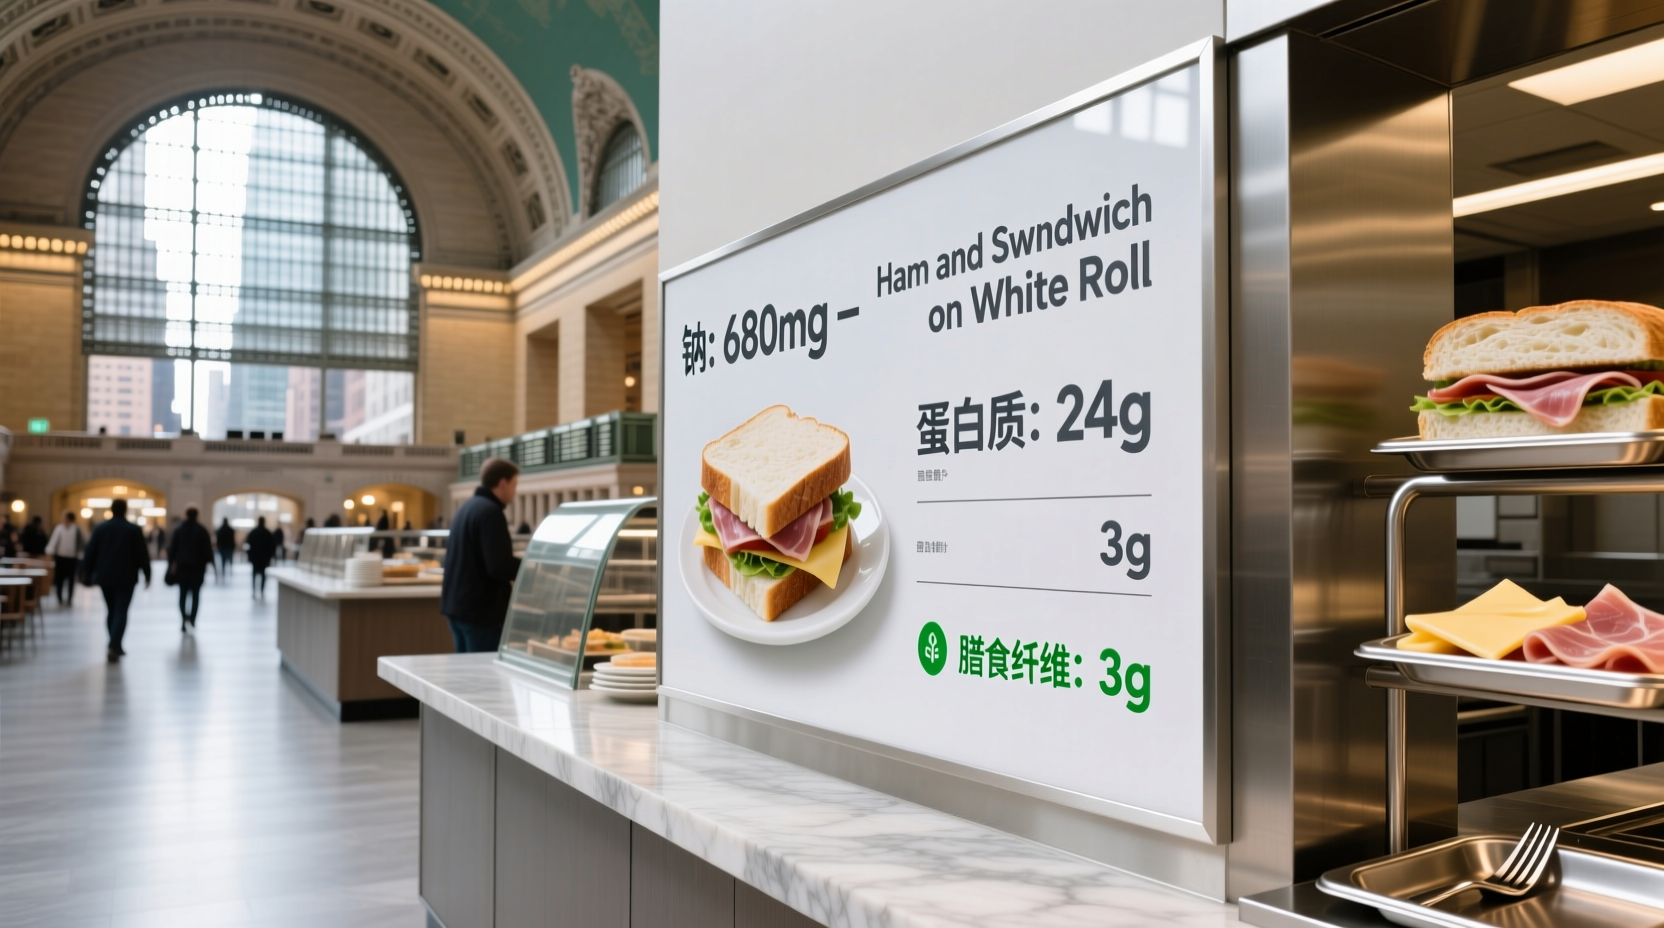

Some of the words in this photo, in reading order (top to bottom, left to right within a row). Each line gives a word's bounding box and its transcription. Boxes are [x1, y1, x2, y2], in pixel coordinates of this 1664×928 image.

[877, 261, 929, 298] Ham
[937, 232, 983, 281] and
[991, 183, 1152, 263] Swndwich
[928, 300, 963, 333] on
[970, 269, 1069, 324] White
[1079, 239, 1152, 302] Roll
[723, 302, 828, 365] 680mg
[916, 389, 1040, 456] 蛋白质:
[1056, 379, 1151, 454] 24g
[1099, 519, 1151, 581] 3g
[1098, 647, 1151, 714] 3g
